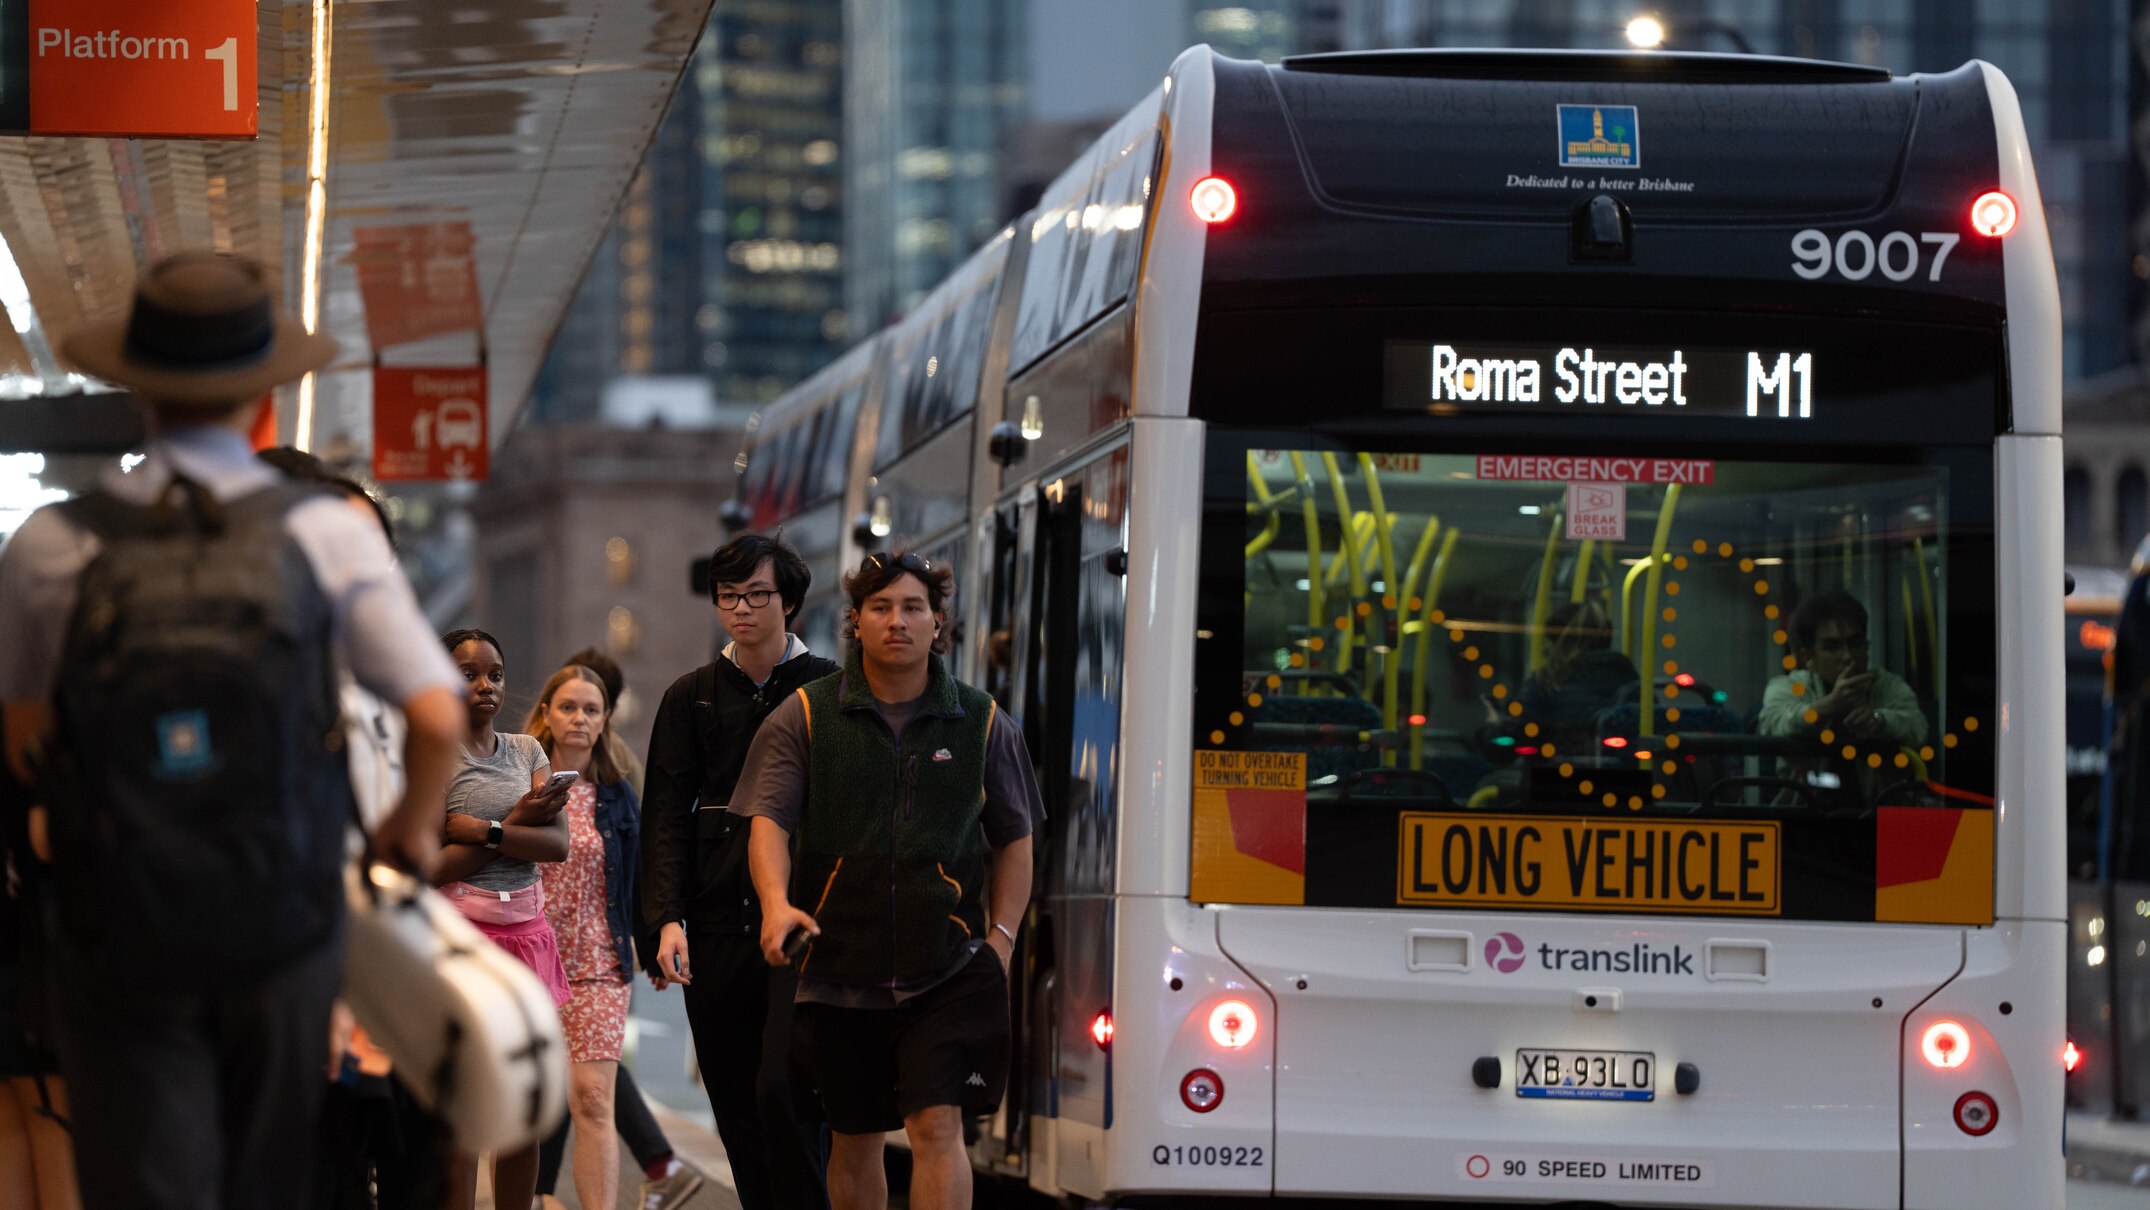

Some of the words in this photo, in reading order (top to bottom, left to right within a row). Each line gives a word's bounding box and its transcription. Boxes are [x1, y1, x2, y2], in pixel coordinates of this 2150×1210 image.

[38, 27, 189, 60] Platform
[204, 37, 239, 112] 1
[1567, 156, 1609, 165] BRISBANE
[1611, 157, 1631, 165] CITY
[1506, 174, 1568, 189] Dedicated
[1571, 177, 1584, 188] to
[1587, 180, 1596, 189] a
[1599, 177, 1635, 190] better
[1638, 178, 1695, 192] Brisbane
[1791, 228, 1960, 282] 9007
[1432, 345, 1541, 402] Roma
[1555, 347, 1687, 405] Street
[1747, 351, 1812, 418] M1
[1480, 457, 1646, 481] EMERGENCY
[1653, 460, 1710, 483] EXIT
[1574, 514, 1617, 525] BREAK
[1574, 525, 1617, 536] GLASS
[1200, 753, 1215, 768] DO
[1219, 753, 1240, 768] NOT
[1244, 753, 1299, 770] OVERTAKE
[1202, 769, 1249, 785] TURNING
[1253, 771, 1298, 787] VEHICLE
[1413, 824, 1541, 897] LONG
[1563, 828, 1765, 902] VEHICLE
[1538, 942, 1694, 976] translink
[1152, 1145, 1264, 1168] Q100922
[1503, 1159, 1526, 1177] 90
[1538, 1160, 1606, 1179] SPEED
[1618, 1161, 1701, 1182] LIMITED
